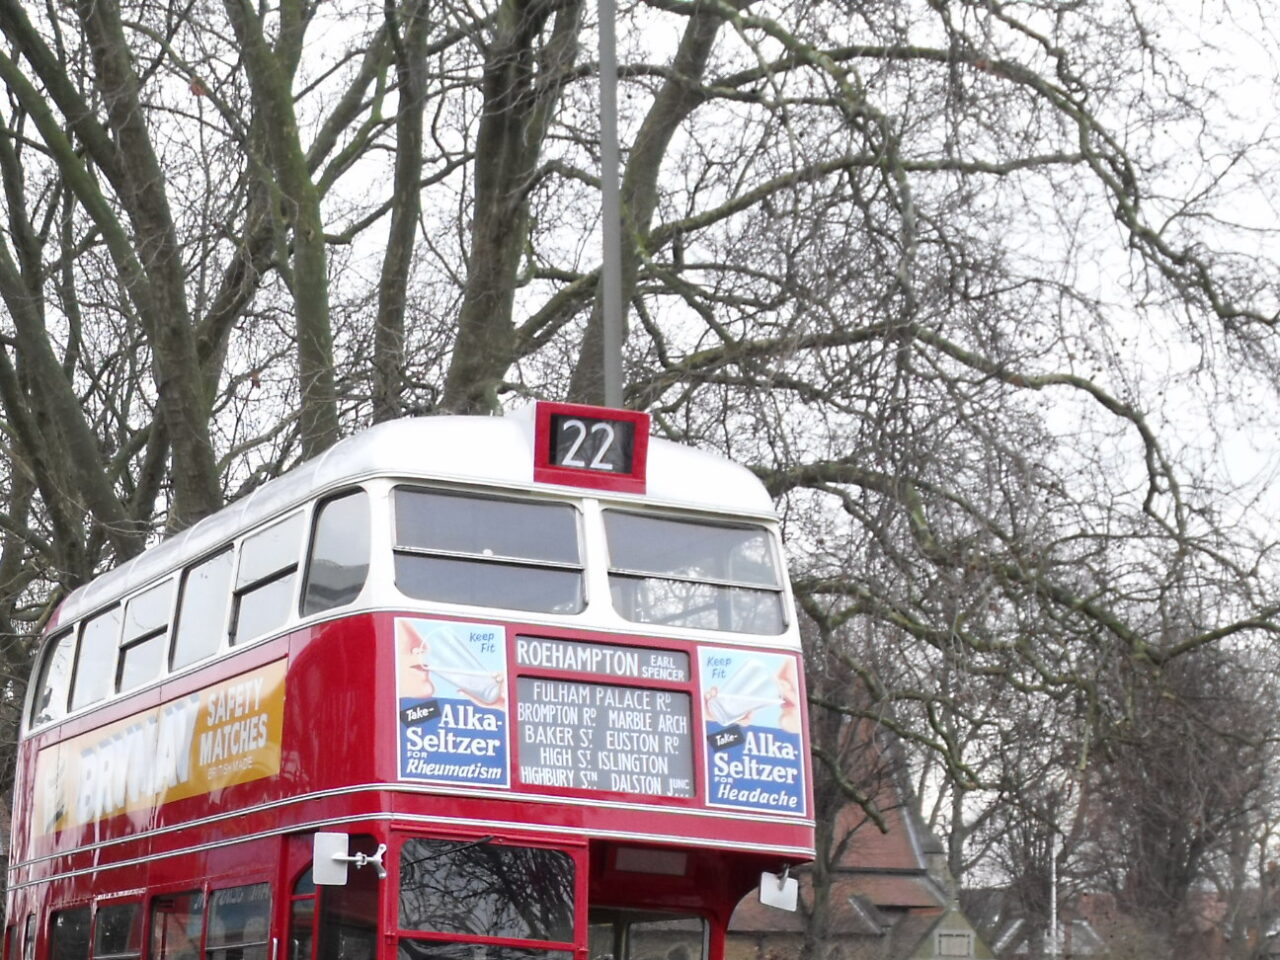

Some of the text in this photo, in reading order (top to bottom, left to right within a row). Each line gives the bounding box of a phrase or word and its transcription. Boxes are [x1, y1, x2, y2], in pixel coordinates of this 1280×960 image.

[561, 418, 615, 470] 22
[469, 631, 495, 642] Keep
[480, 642, 496, 653] Fit
[516, 639, 639, 677] ROEHAMPTON
[649, 654, 676, 669] EARL
[706, 655, 733, 667] Keep
[641, 666, 685, 682] SPENCER
[711, 668, 727, 680] Fit
[206, 677, 265, 727] SAFETY
[533, 682, 590, 704] FULHAM
[595, 686, 651, 710] PALACE
[517, 702, 579, 726] BROMPTON
[608, 709, 653, 731] MARBLE
[657, 714, 688, 735] ARCH
[199, 713, 269, 767] MATCHES
[406, 726, 501, 757] Seltzer
[524, 724, 574, 746] BAKER
[606, 730, 659, 753] EUSTON
[407, 750, 428, 759] FOR
[540, 747, 572, 767] HIGH
[598, 751, 669, 775] ISLINGTON
[713, 752, 798, 785] Seltzer
[405, 758, 503, 780] Rheumatism
[520, 765, 574, 788] HIGHBURY
[611, 773, 662, 795] DALSTON
[714, 776, 734, 785] FOR
[717, 784, 798, 808] Headache
